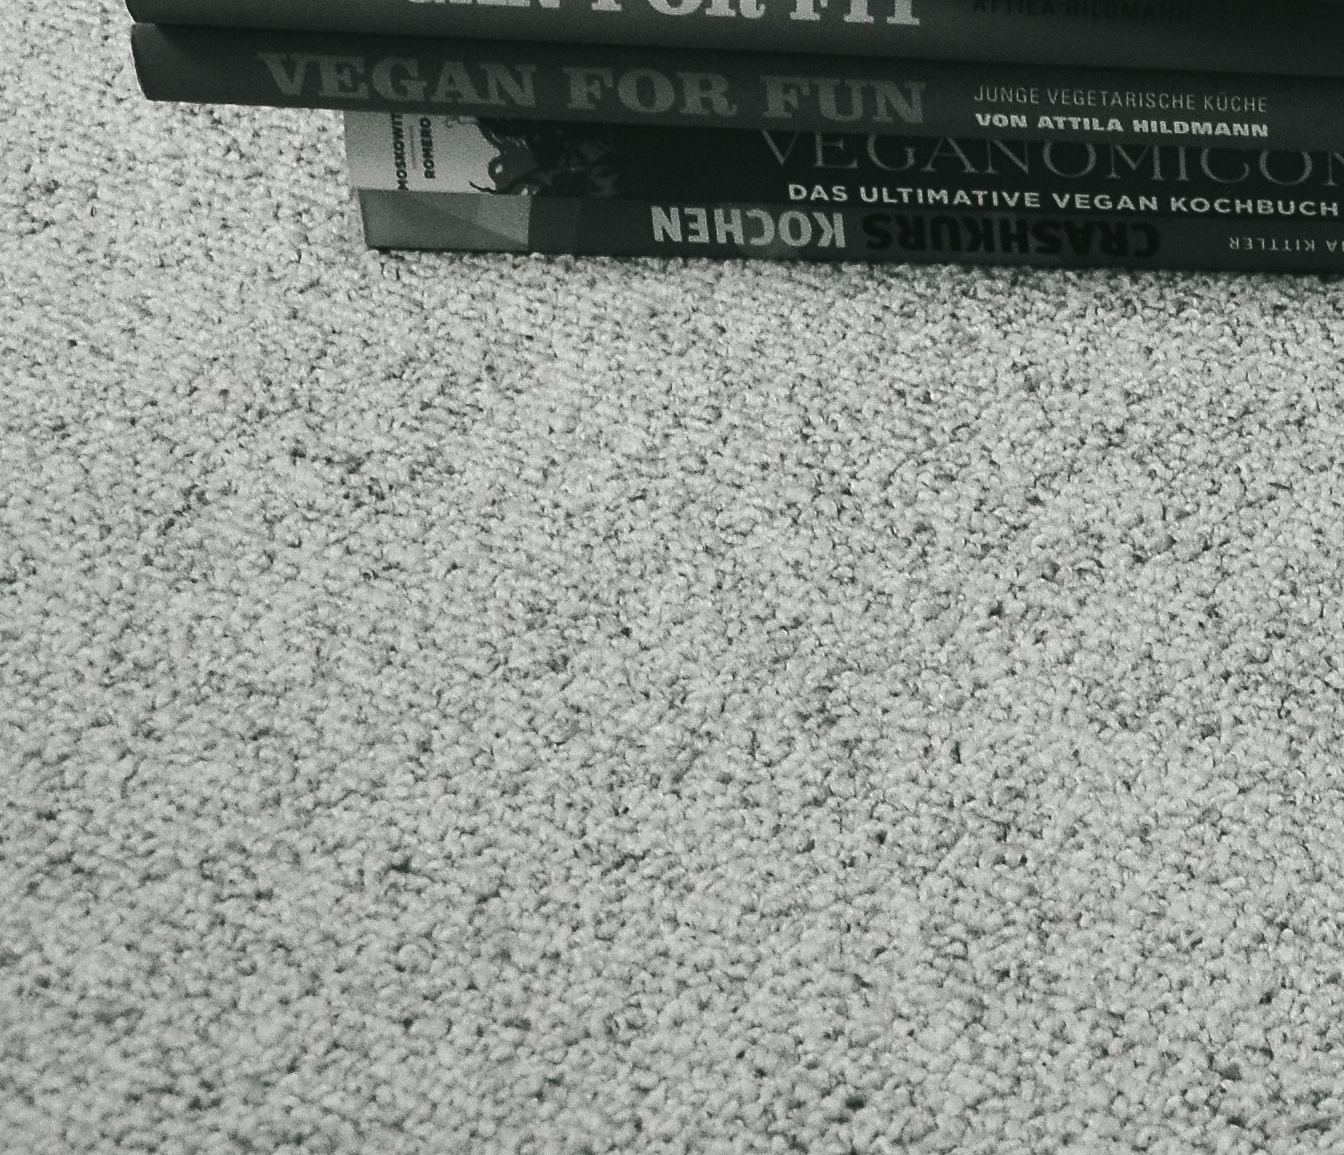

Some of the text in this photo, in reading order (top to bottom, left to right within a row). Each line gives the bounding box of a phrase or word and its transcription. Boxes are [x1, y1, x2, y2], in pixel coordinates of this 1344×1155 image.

[257, 51, 927, 125] VEGAN FOR FUN
[973, 85, 1269, 114] JUNGE VEGETARISCHE KÜCHE
[973, 112, 1269, 138] VON ATTILA HILDMANN
[420, 116, 436, 180] ROMERO
[787, 181, 1340, 219] DAS ULTIMATIVE VEGAN KOCHBUCH
[649, 204, 1161, 260] CRASHKURS KOCHEN
[1227, 234, 1316, 254] KITTLER
